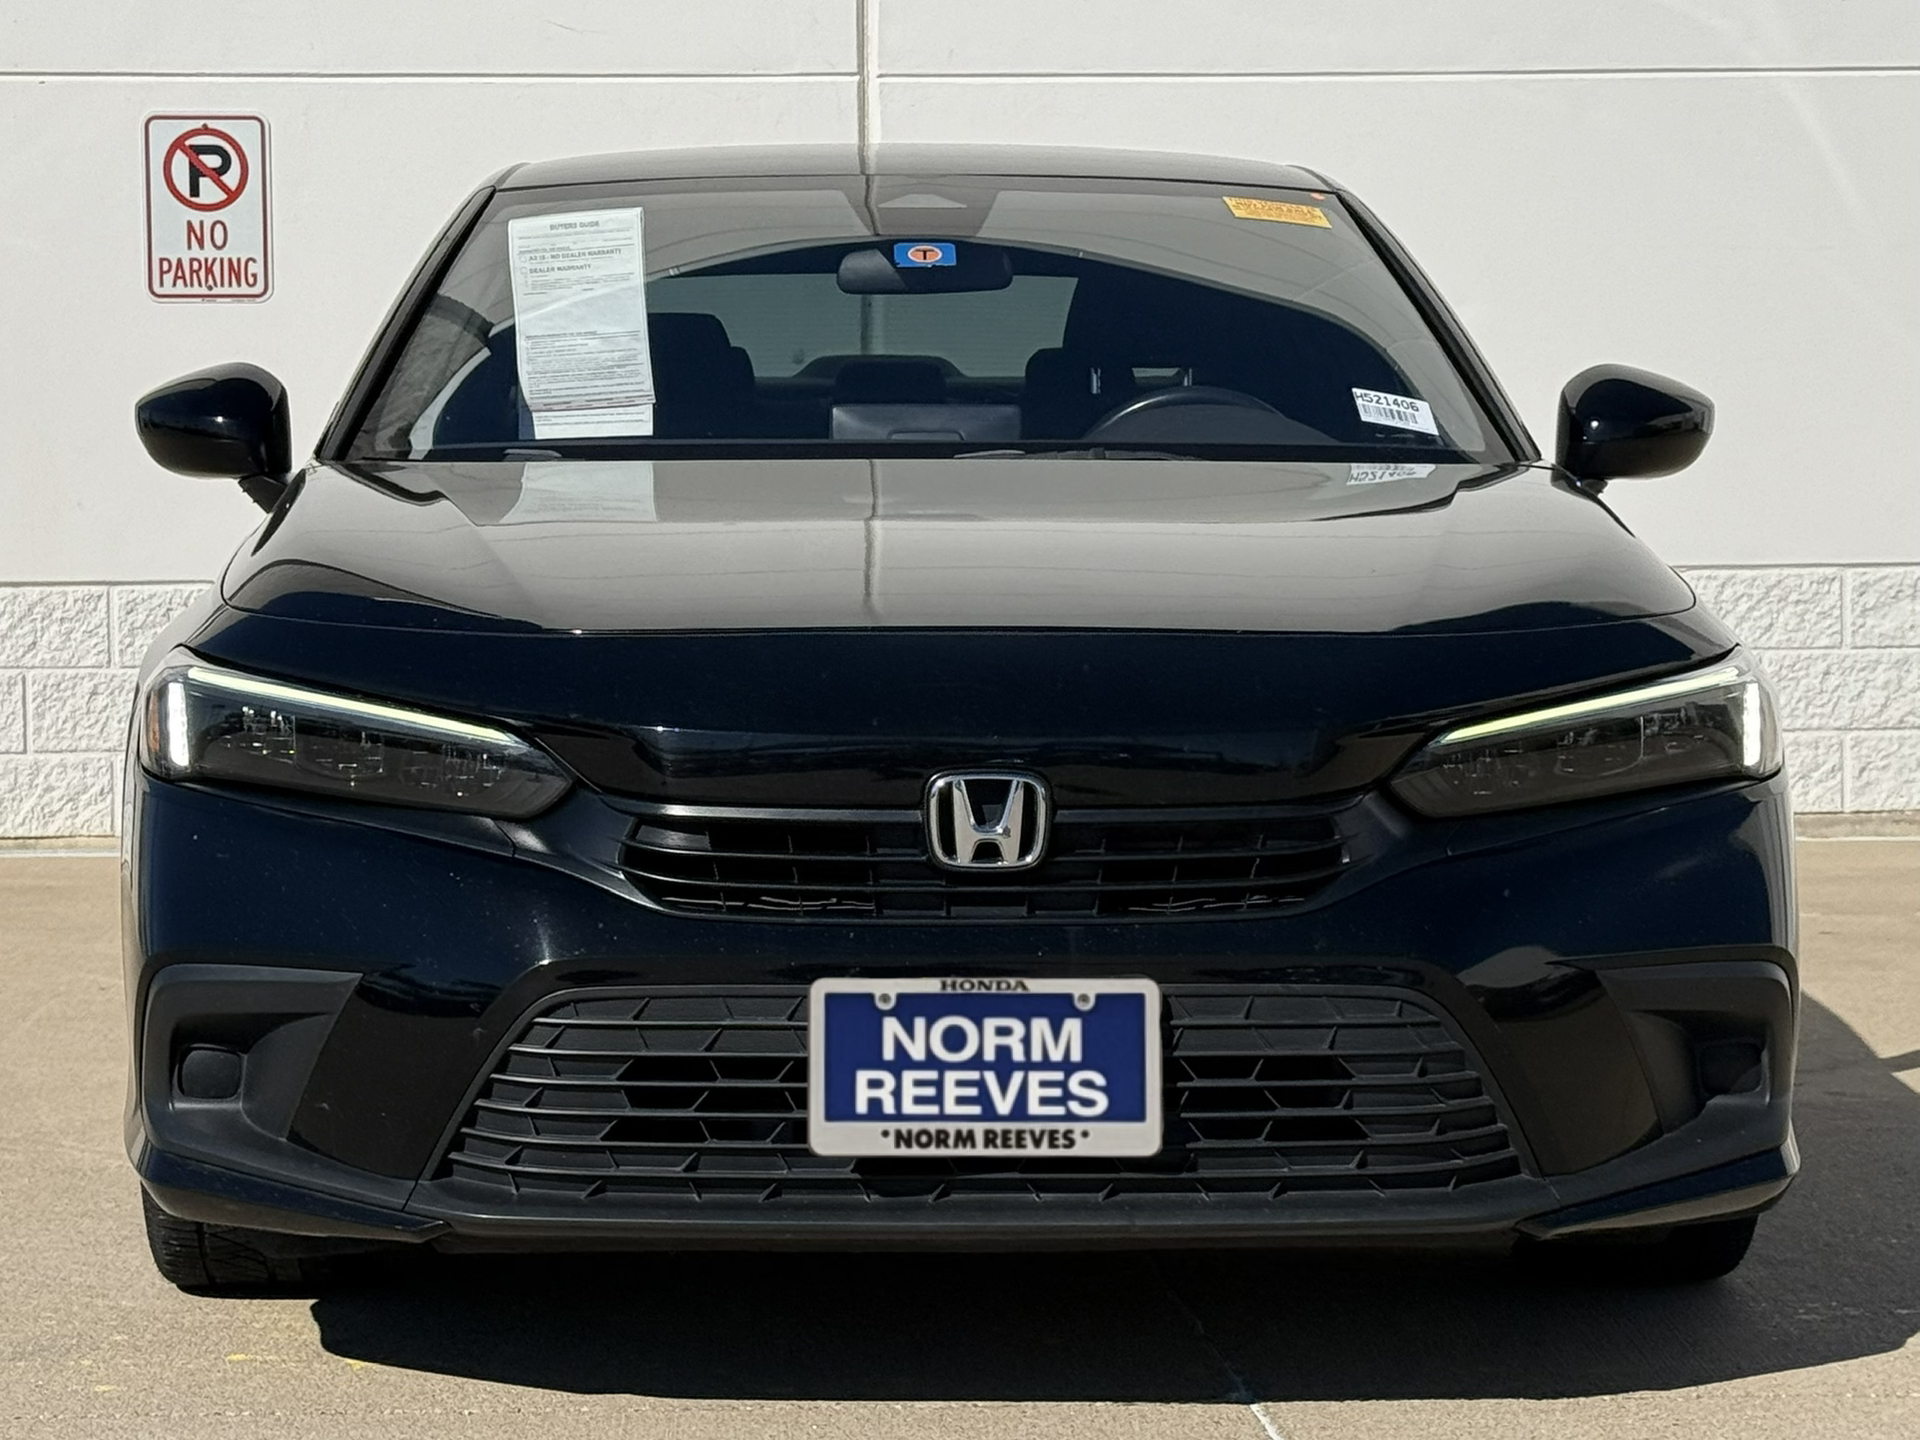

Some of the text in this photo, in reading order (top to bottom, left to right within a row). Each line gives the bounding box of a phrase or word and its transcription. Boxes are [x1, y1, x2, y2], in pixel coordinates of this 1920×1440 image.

[186, 219, 228, 251] NO
[915, 248, 935, 261] T
[158, 257, 258, 288] PARKING
[1354, 391, 1420, 412] H521406
[940, 979, 1030, 992] HONDA
[882, 1015, 1083, 1063] NORM
[855, 1069, 1109, 1117] REEVES
[894, 1128, 1076, 1150] NORM REEVES
